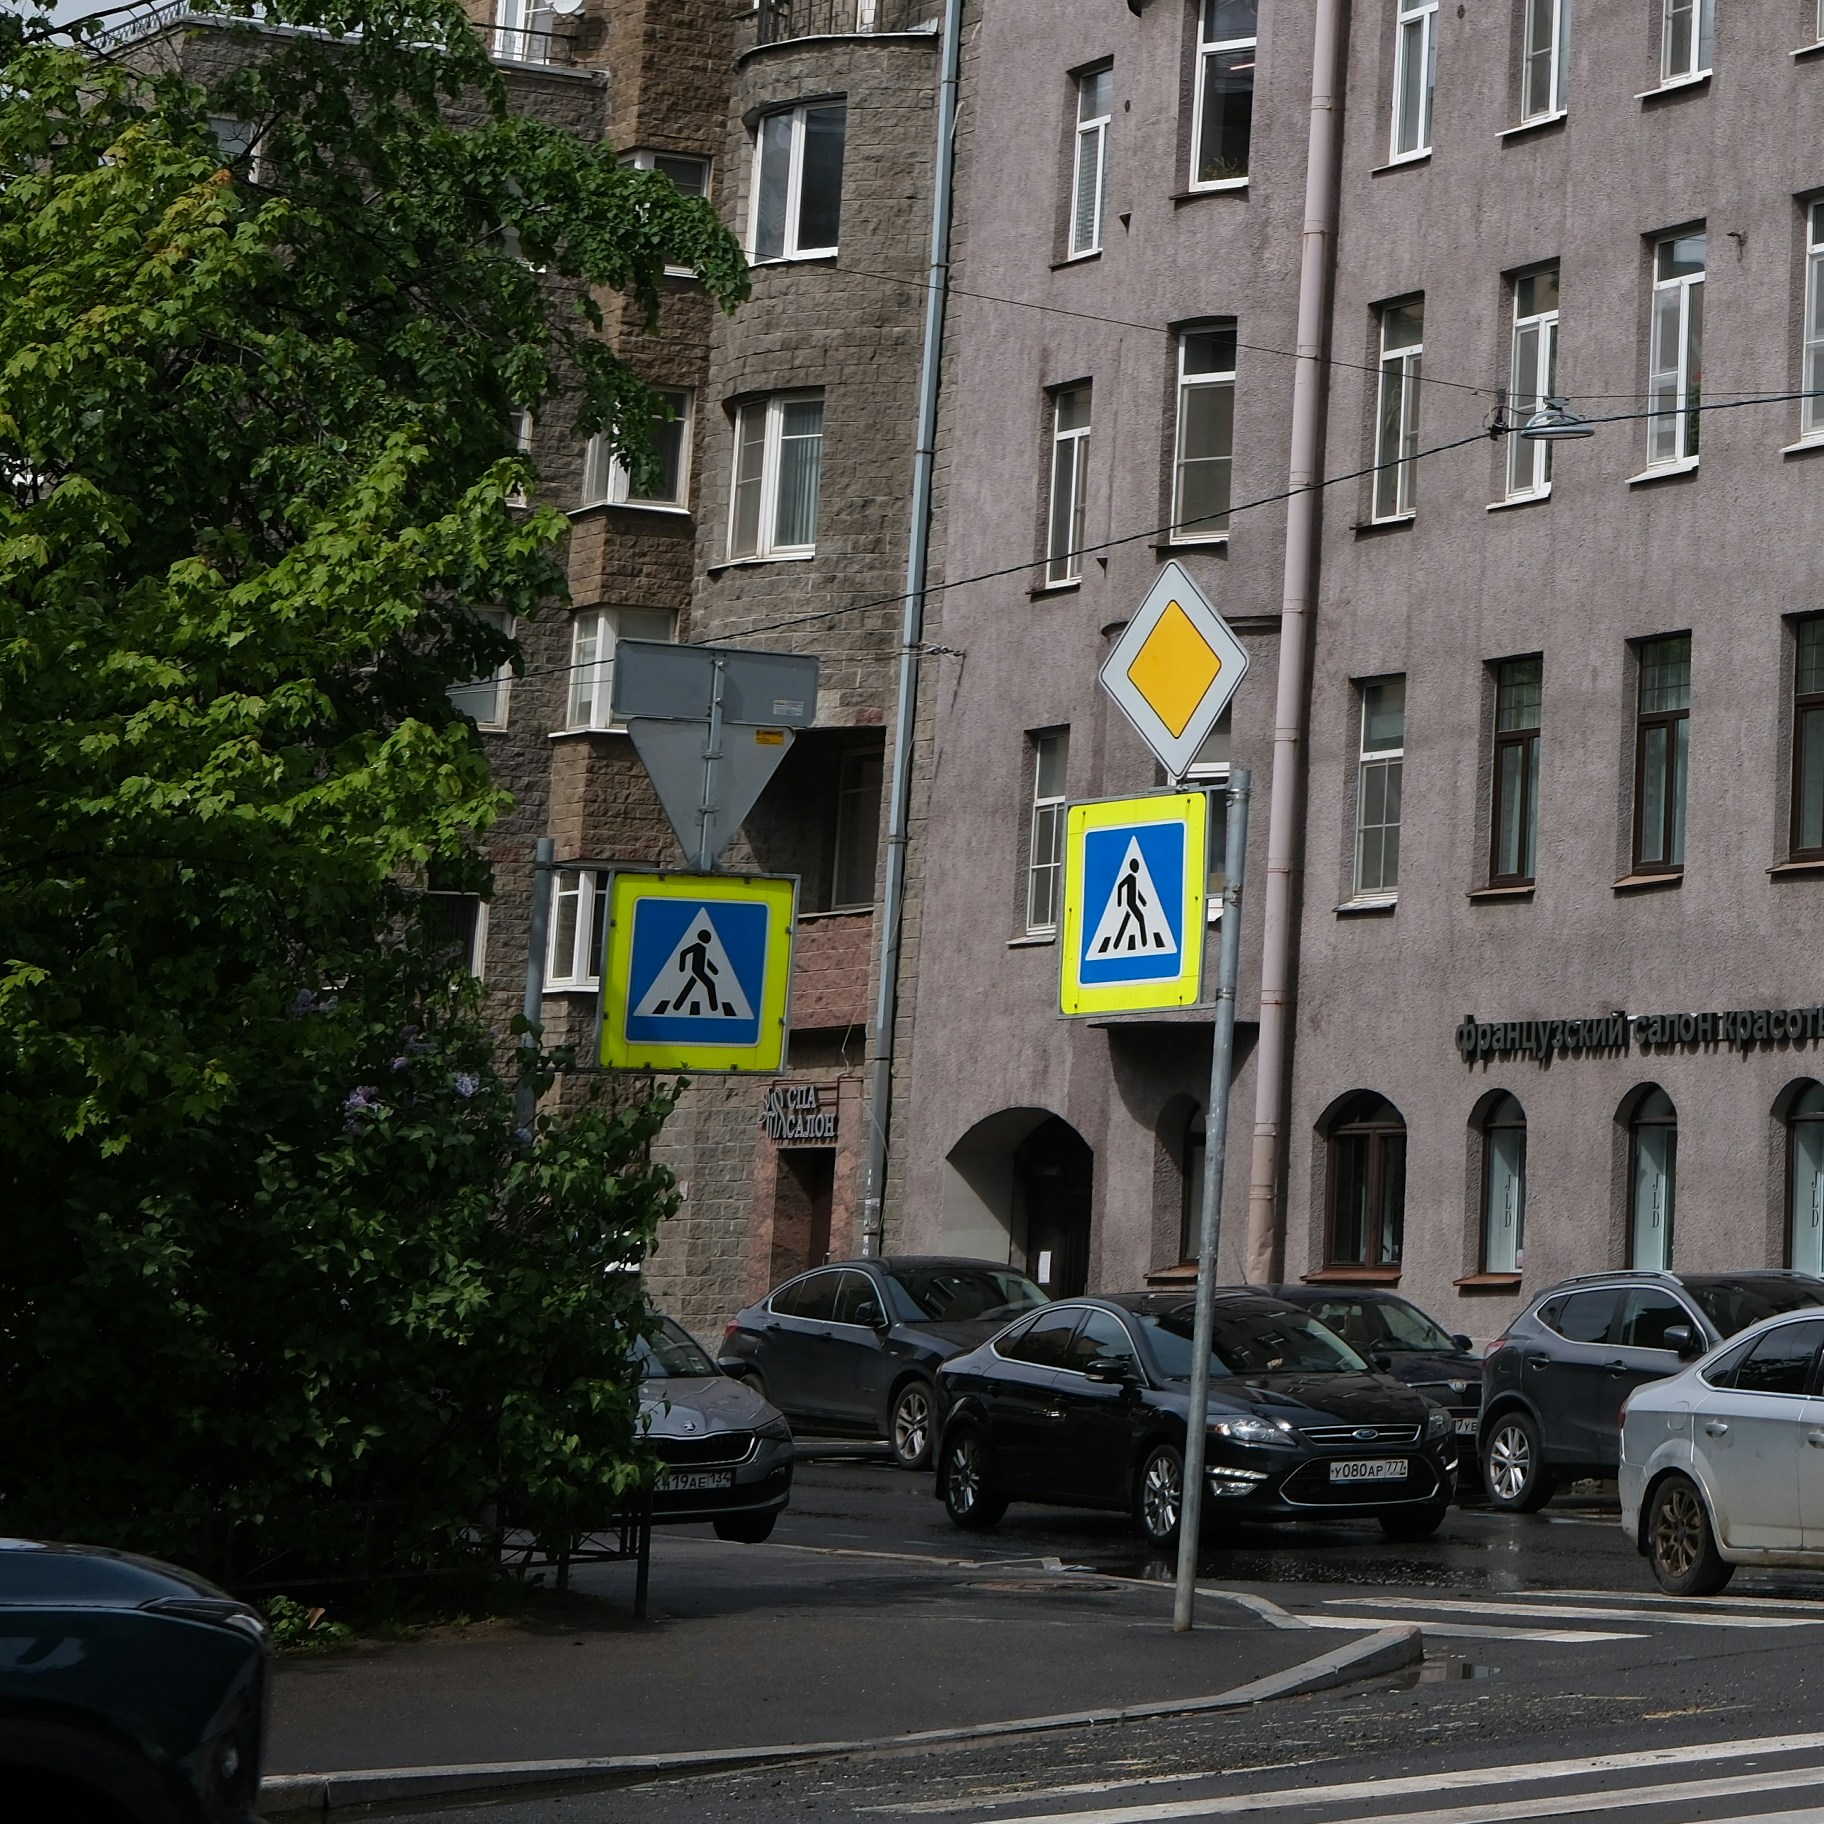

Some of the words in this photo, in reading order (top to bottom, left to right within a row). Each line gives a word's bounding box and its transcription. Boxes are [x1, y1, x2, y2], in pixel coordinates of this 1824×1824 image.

[1456, 1012, 1627, 1061] французский
[1633, 1012, 1714, 1044] салон
[788, 1086, 817, 1108] СПА
[787, 1114, 835, 1138] САЛОН
[1334, 1462, 1384, 1478] У080АР
[1385, 1460, 1405, 1475] 777
